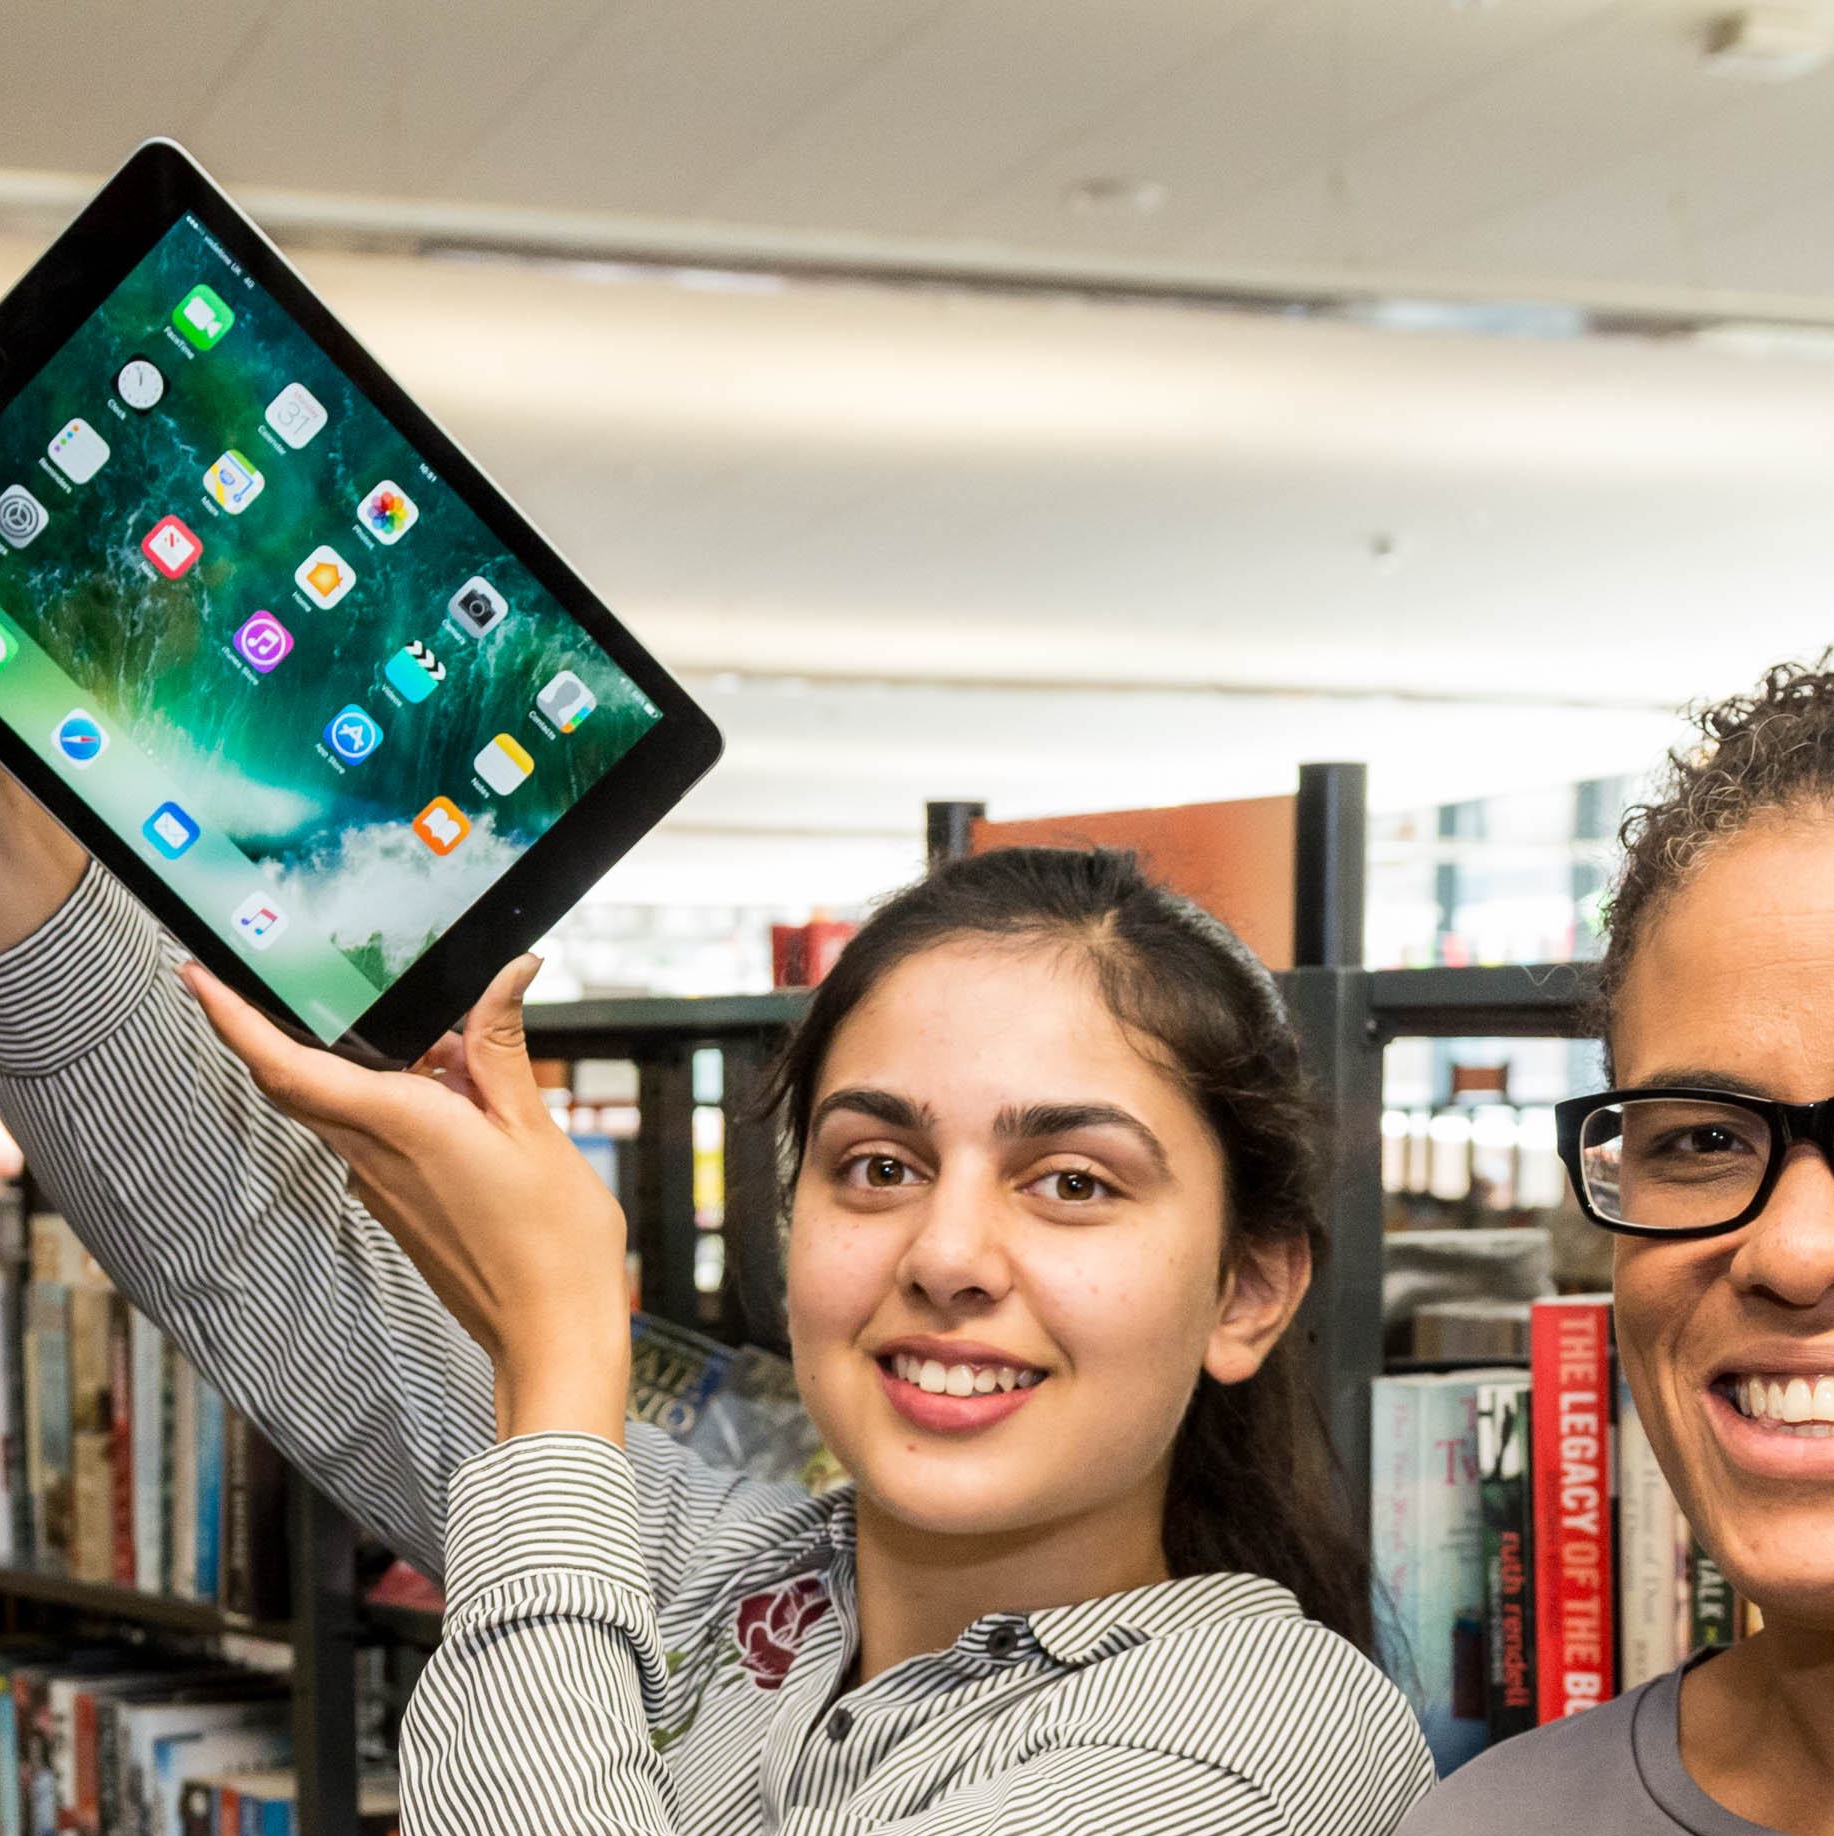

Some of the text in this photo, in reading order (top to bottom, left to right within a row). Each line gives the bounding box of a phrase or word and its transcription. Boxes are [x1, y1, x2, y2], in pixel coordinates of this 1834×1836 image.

[164, 325, 194, 360] FaceTime
[107, 398, 126, 420] Clock
[38, 456, 72, 494] Reminders
[201, 495, 219, 516] Maps
[292, 590, 312, 612] Home
[239, 665, 258, 686] Store
[528, 710, 556, 741] Contacts
[326, 755, 345, 774] Store
[470, 777, 489, 799] Notes
[1560, 1314, 1600, 1664] THE LEGACY OF THE
[1502, 1532, 1529, 1706] ruth rendell
